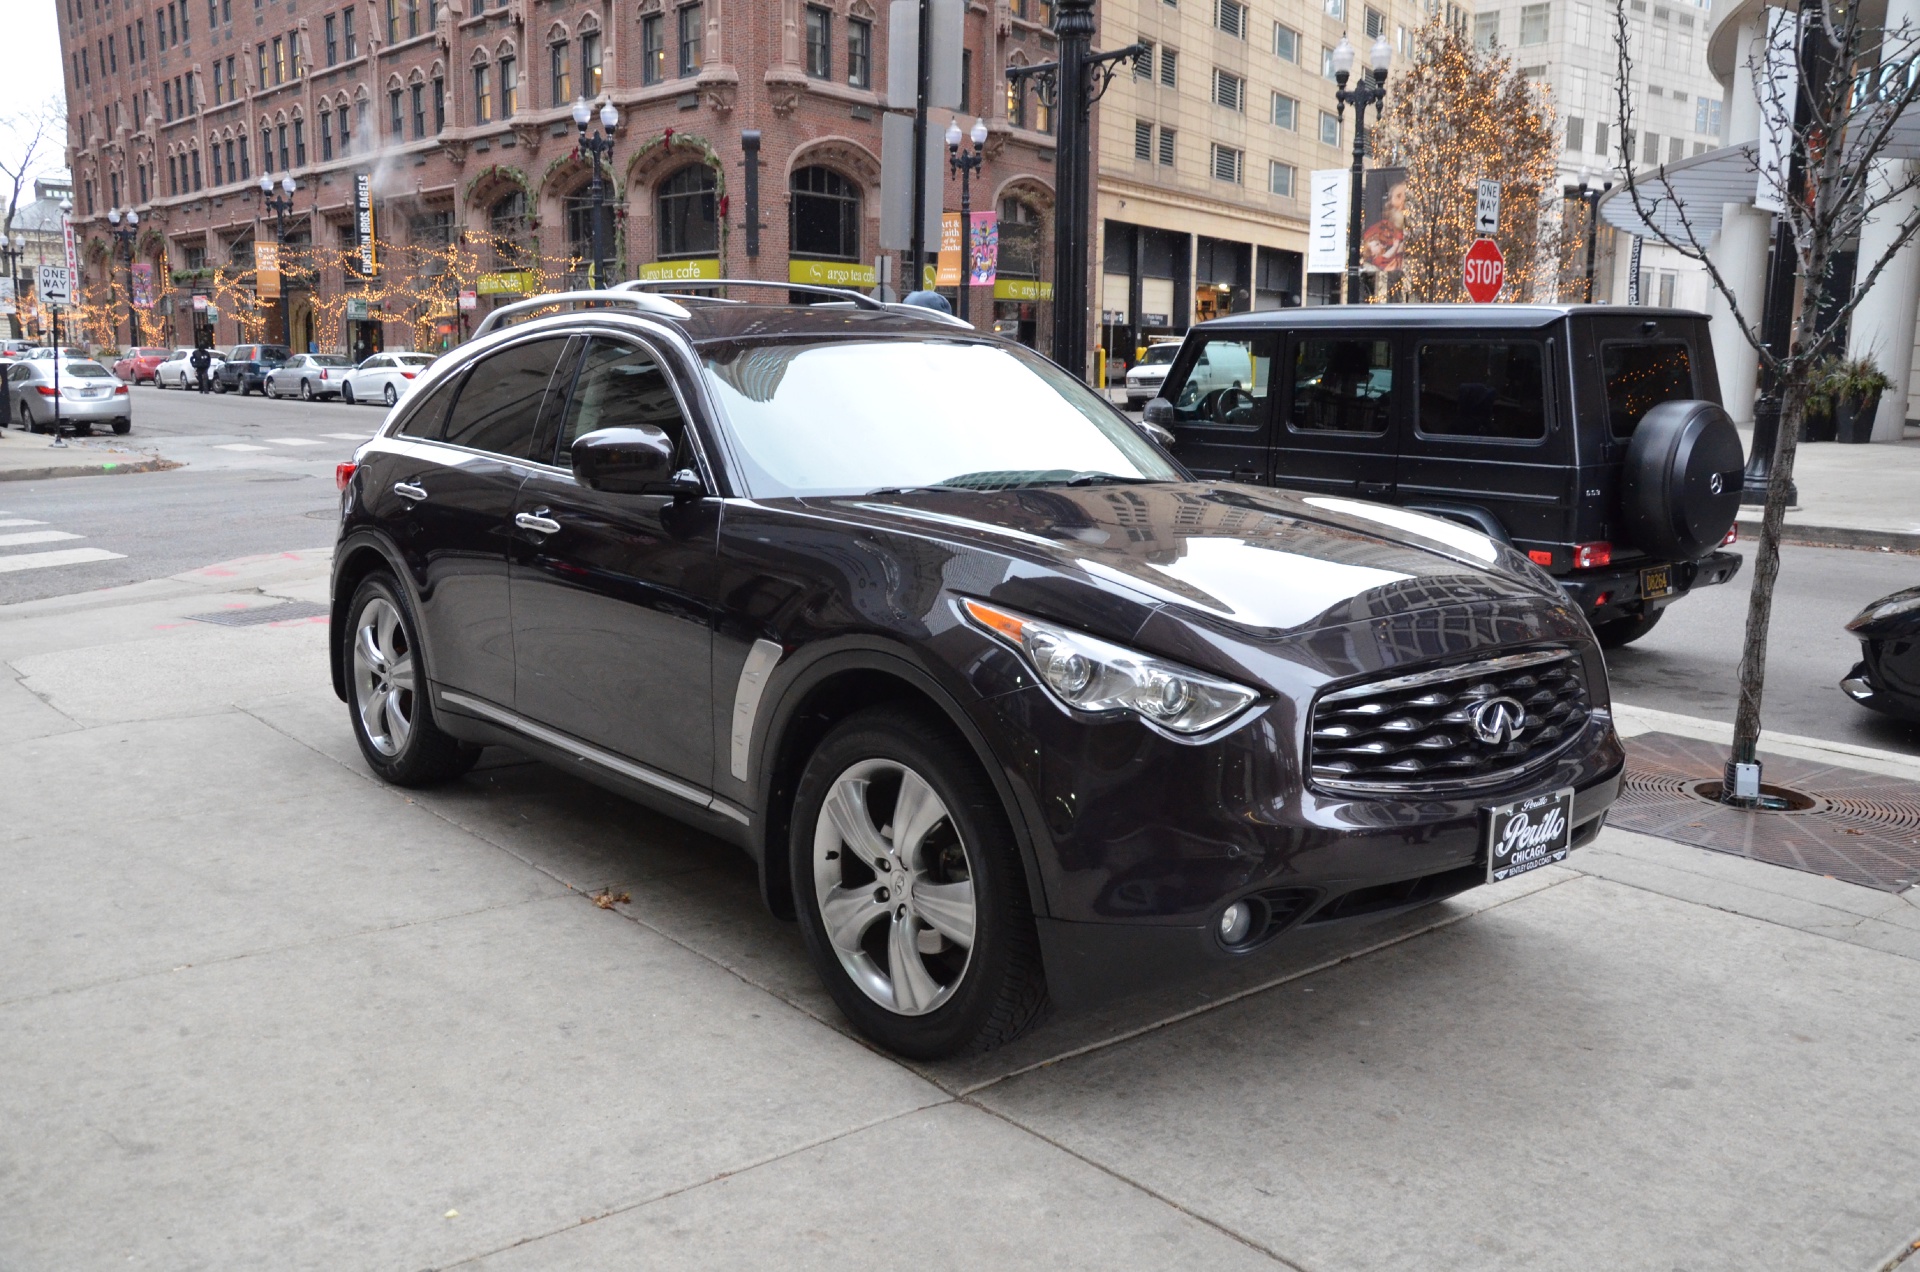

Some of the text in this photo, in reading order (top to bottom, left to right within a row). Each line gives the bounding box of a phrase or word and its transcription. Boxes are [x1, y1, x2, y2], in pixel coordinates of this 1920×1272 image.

[359, 175, 370, 209] BAGELS
[1481, 184, 1498, 198] ONE
[1480, 199, 1498, 213] WAY
[1319, 183, 1338, 252] LUMA
[1630, 235, 1640, 282] ORDSTROM
[43, 268, 66, 279] ONE
[675, 261, 701, 278] café
[827, 269, 849, 284] argo
[850, 269, 862, 282] tea
[1466, 258, 1502, 284] STOP
[42, 279, 67, 290] WAY
[1521, 796, 1548, 812] Perillo
[1495, 807, 1565, 857] Perillo
[1511, 843, 1547, 864] CHICAGO
[1509, 855, 1552, 876] BENTLEY GOLD COAST
